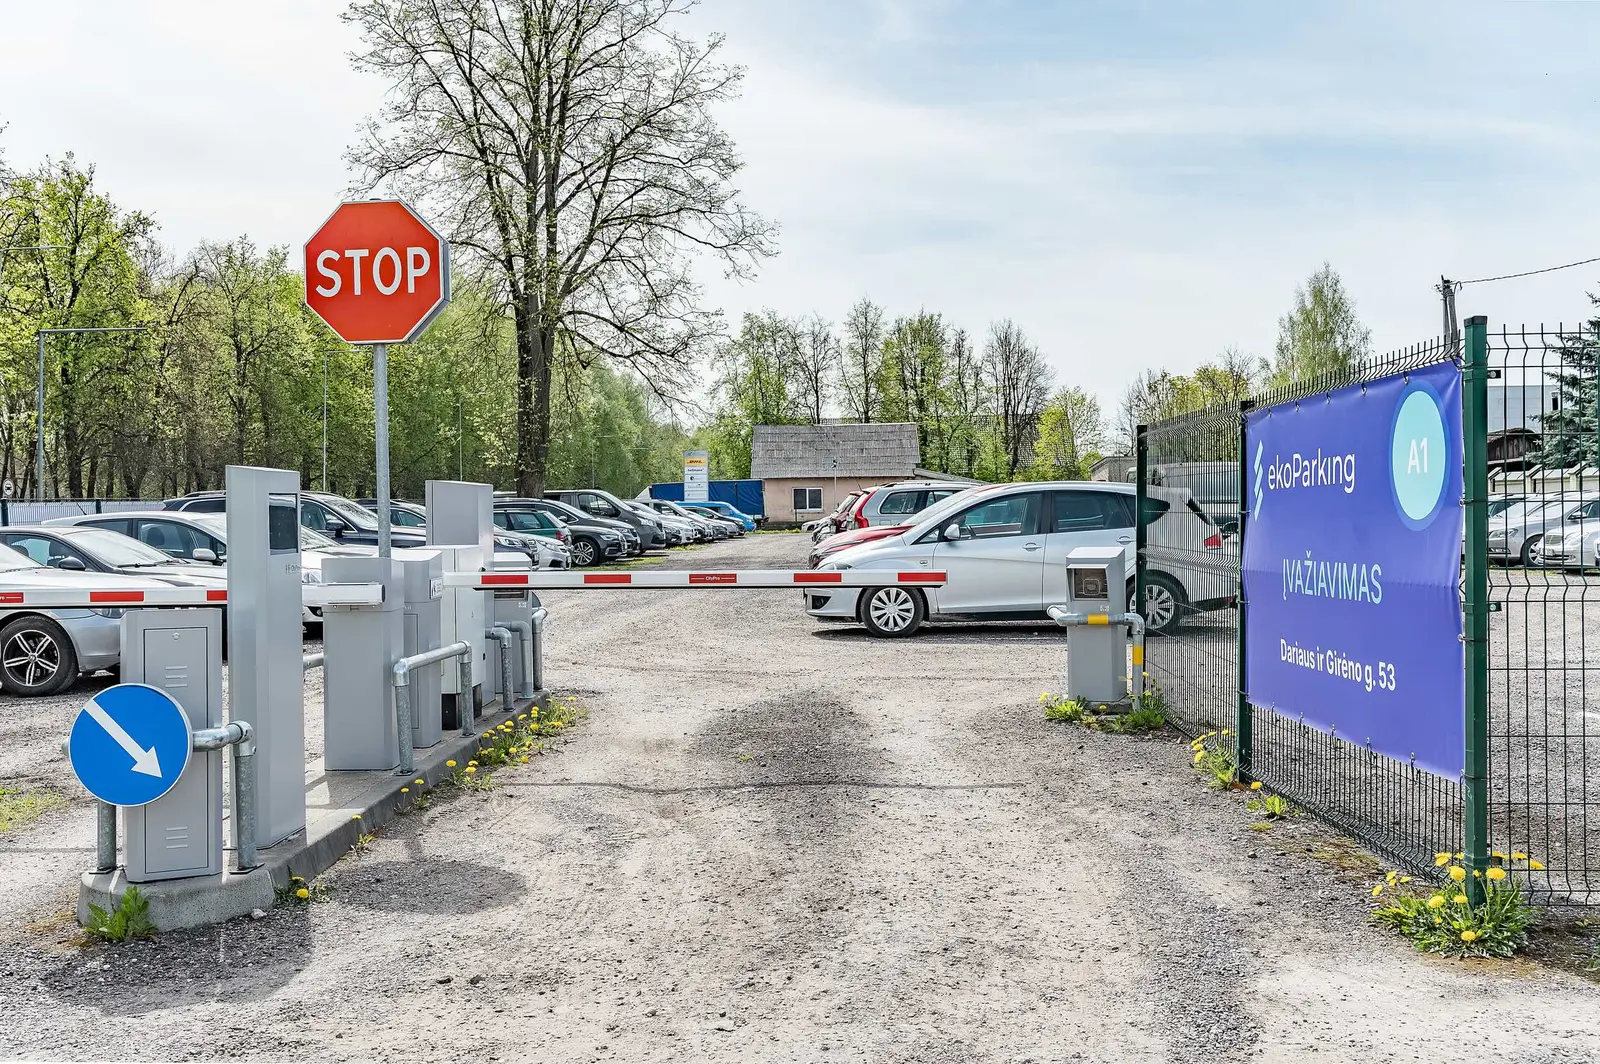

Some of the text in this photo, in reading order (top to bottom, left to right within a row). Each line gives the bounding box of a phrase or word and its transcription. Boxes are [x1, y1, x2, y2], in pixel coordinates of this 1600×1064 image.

[315, 246, 431, 298] STOP
[1407, 437, 1428, 475] A1
[1283, 550, 1382, 604] ĮVAŽIAVIMAS
[1280, 638, 1315, 670] Dariaus
[1316, 646, 1324, 672] ir
[1364, 664, 1376, 692] g.
[1378, 661, 1396, 691] 53
